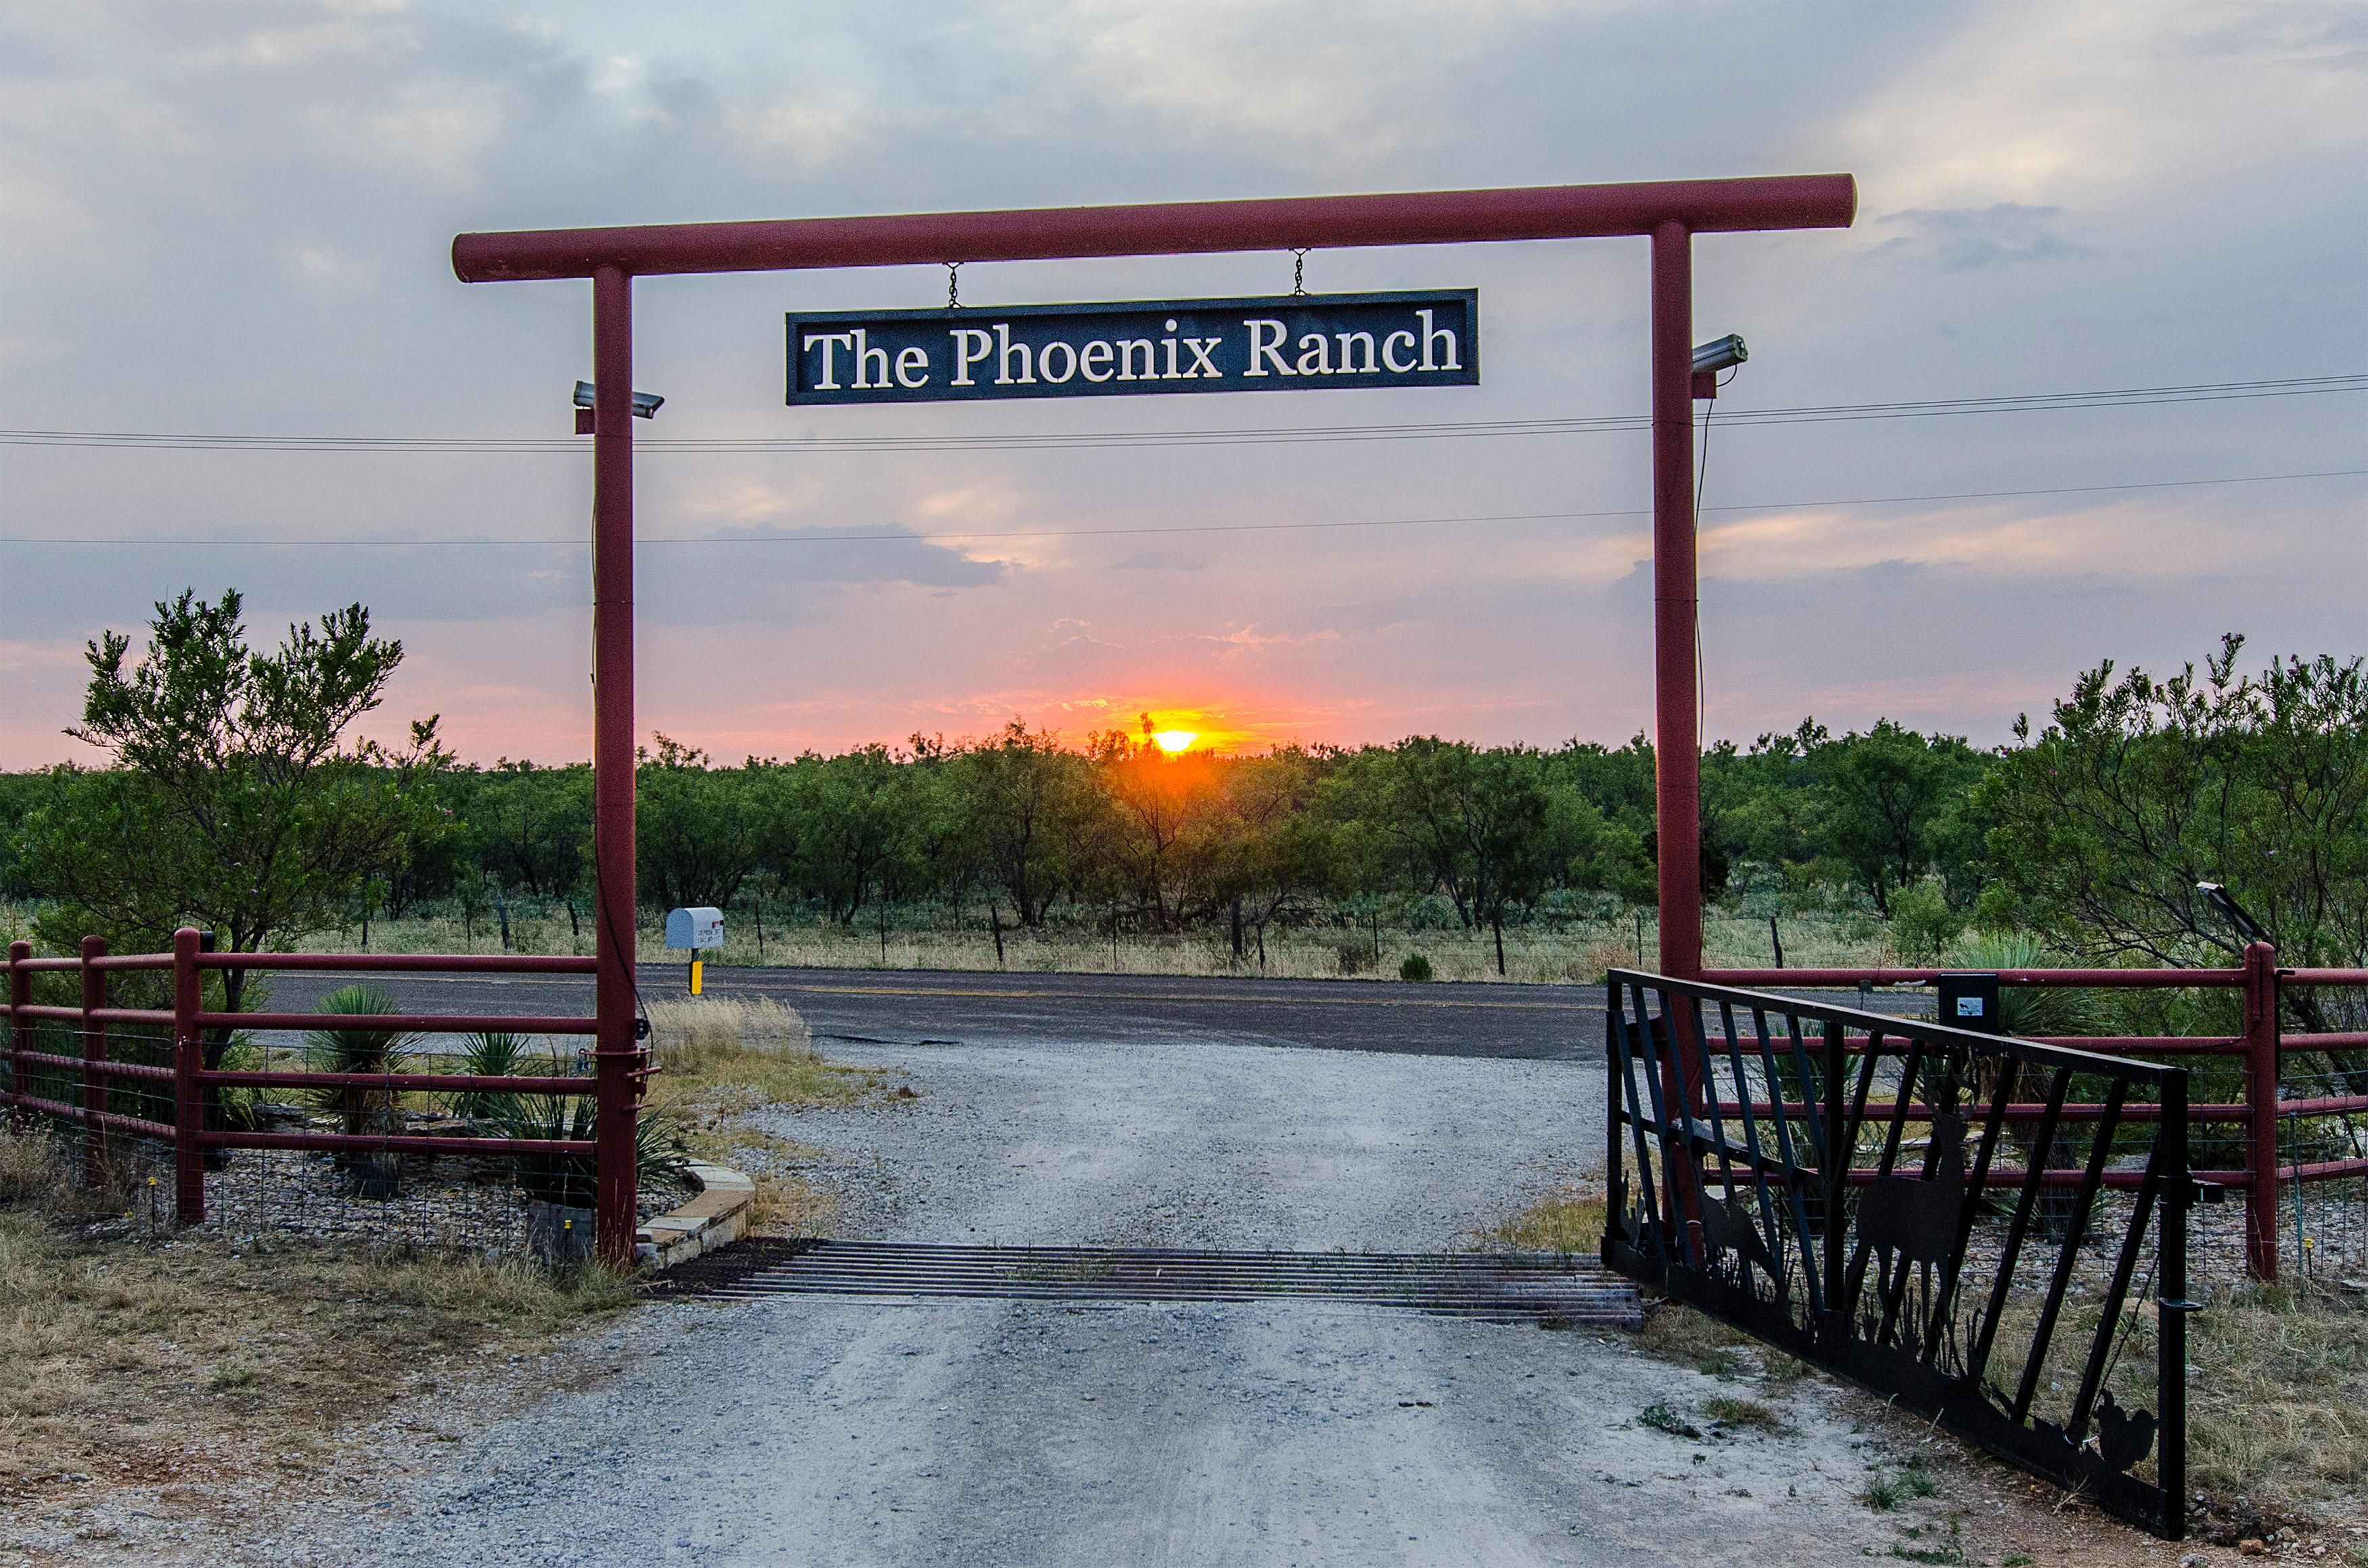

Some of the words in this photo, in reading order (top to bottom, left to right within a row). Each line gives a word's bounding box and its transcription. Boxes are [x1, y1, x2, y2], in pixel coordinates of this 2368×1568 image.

[804, 328, 930, 390] The
[949, 319, 1223, 386] Phoenix
[1243, 309, 1462, 377] Ranch
